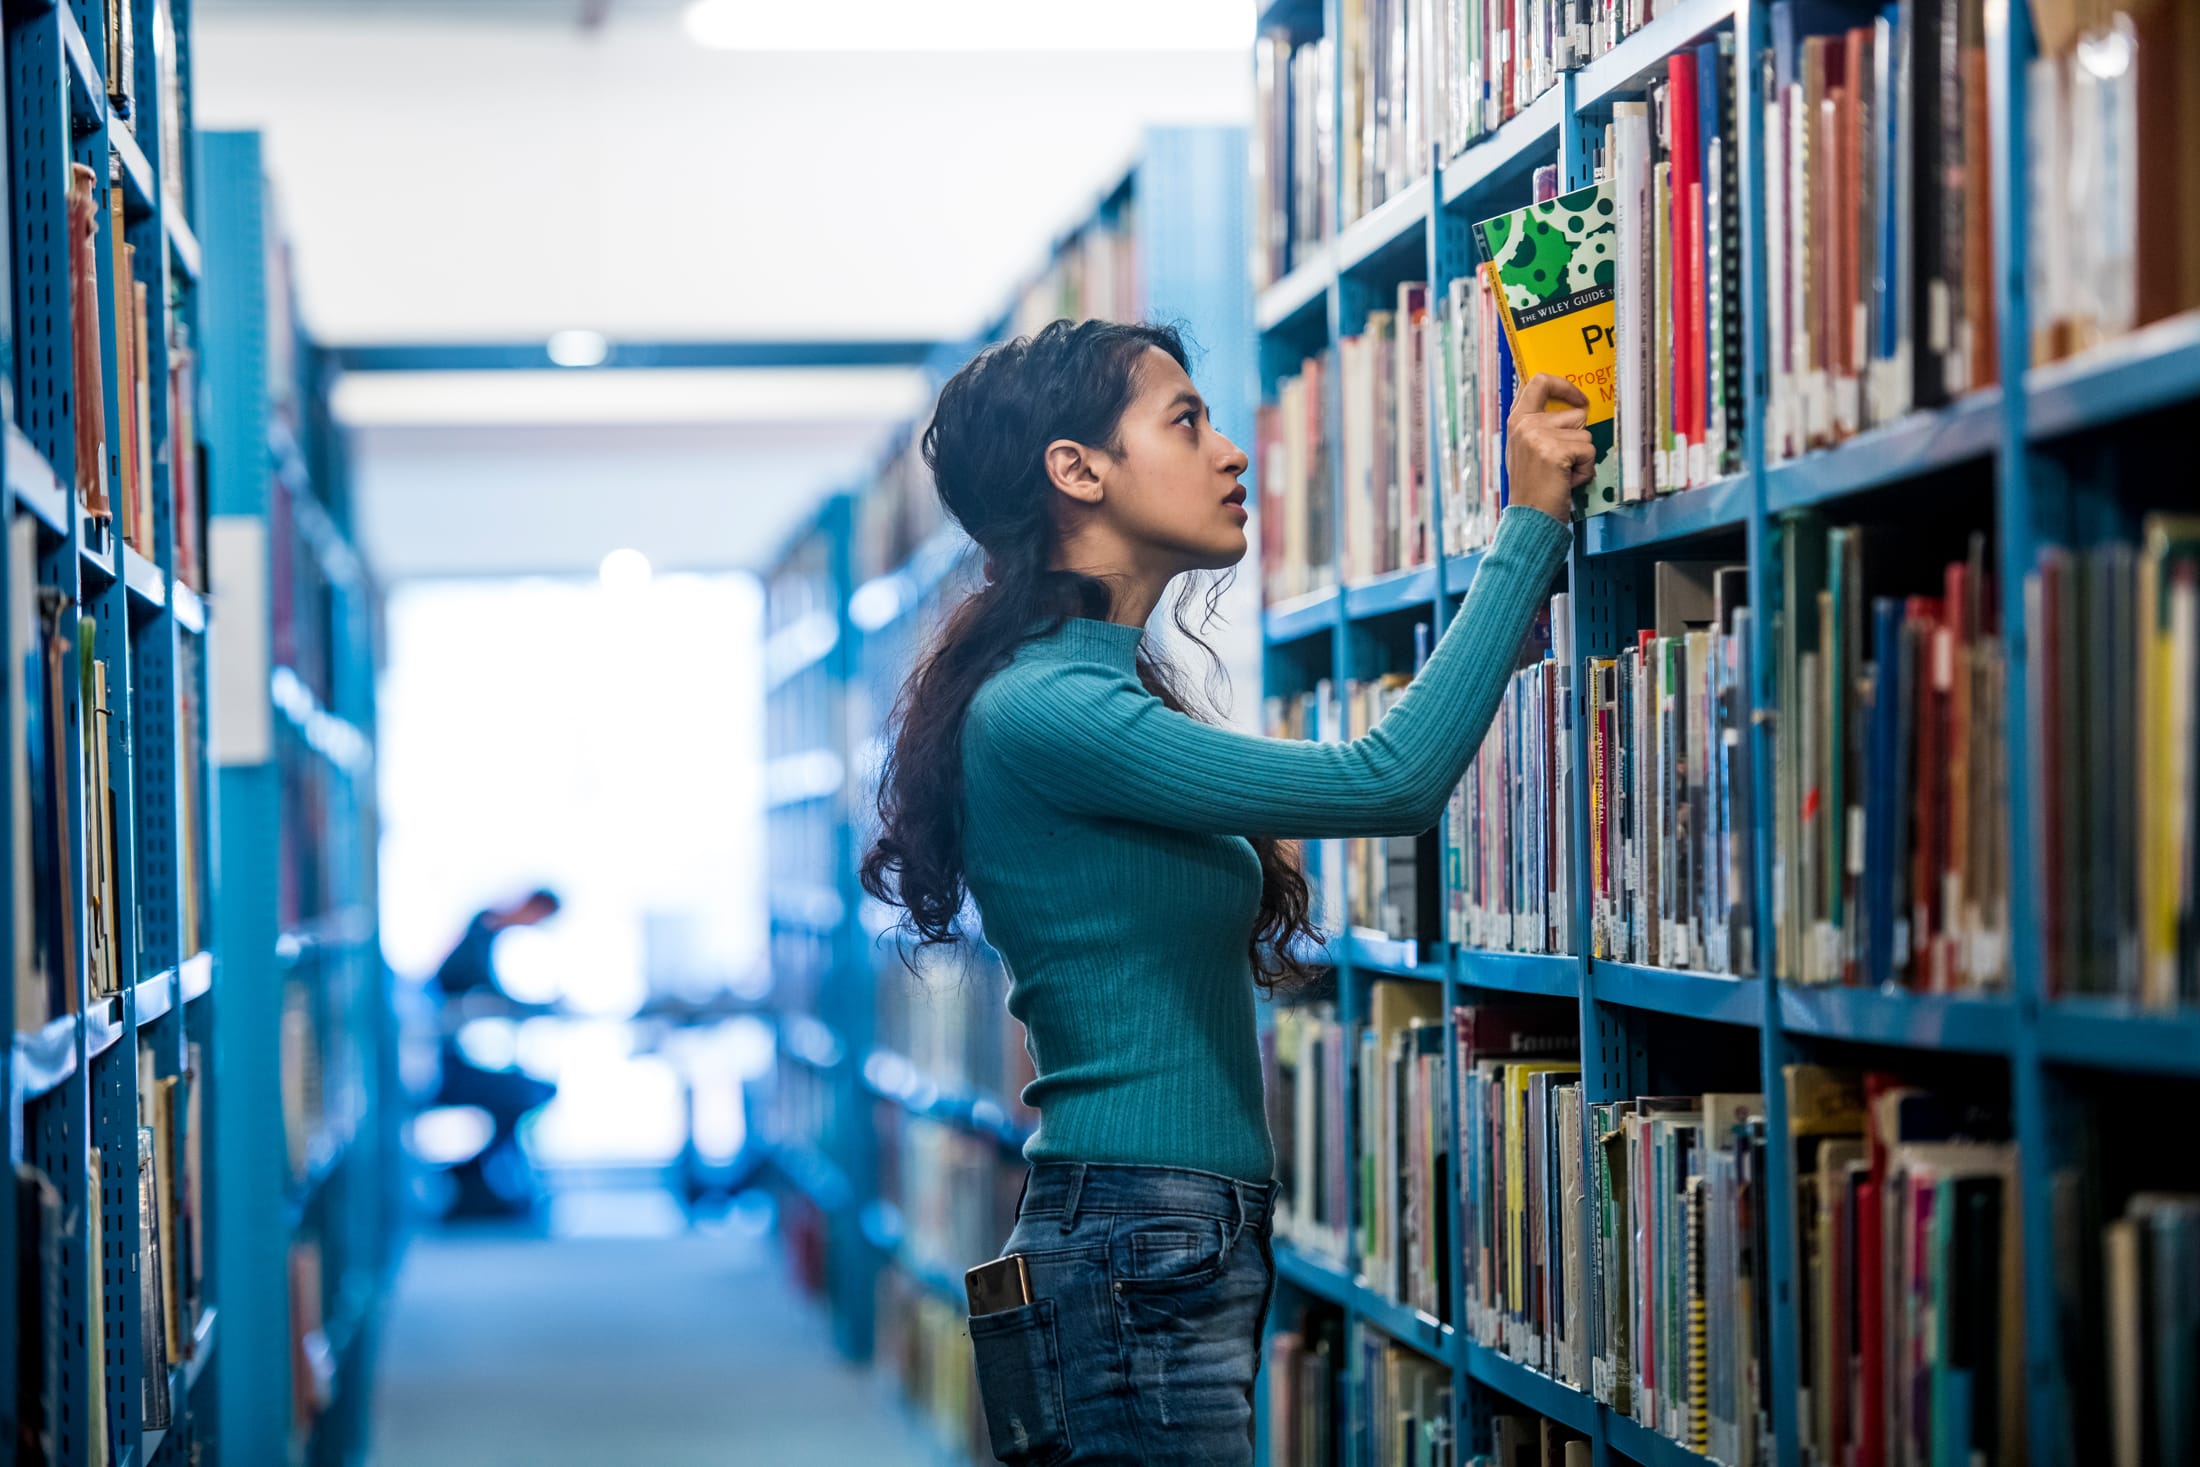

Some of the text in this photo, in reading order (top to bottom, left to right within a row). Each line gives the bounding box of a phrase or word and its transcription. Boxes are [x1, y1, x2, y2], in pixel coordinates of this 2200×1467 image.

[1520, 313, 1537, 324] THE
[1538, 300, 1570, 317] WILEY
[1573, 288, 1606, 306] GUIDE
[1592, 1114, 1601, 1192] RUGBY
[1595, 1201, 1603, 1276] TOUGH
